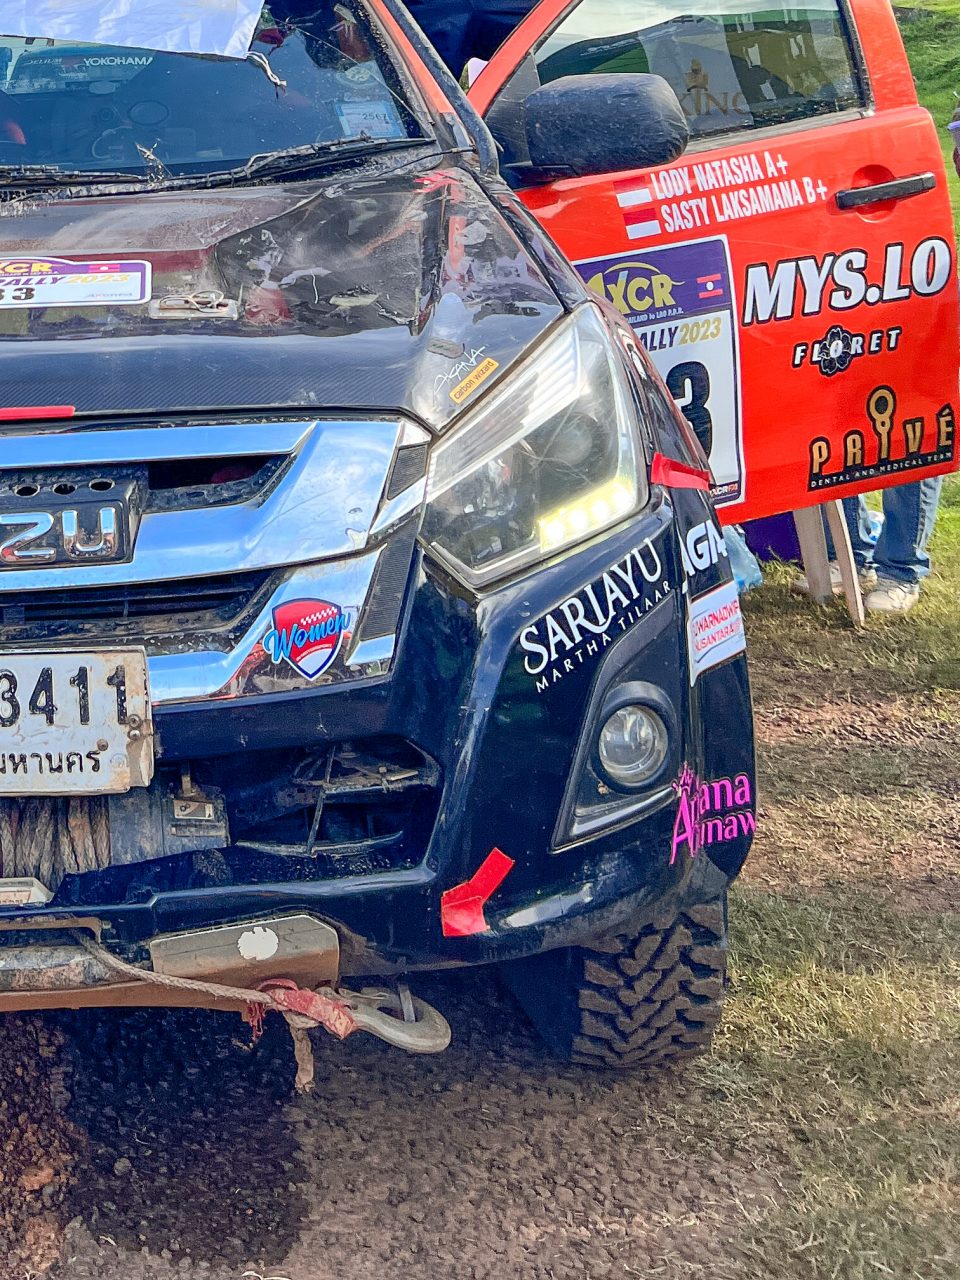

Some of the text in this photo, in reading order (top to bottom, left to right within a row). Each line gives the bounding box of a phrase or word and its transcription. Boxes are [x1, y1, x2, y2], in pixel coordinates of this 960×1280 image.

[650, 150, 788, 201] LODY NATASHA A+
[660, 176, 828, 234] SASTY LAKSAMANA B+
[66, 274, 130, 285] 2023
[742, 236, 952, 326] MYS.LO
[639, 317, 722, 352] ALLY 2023
[792, 327, 902, 368] FLORET
[474, 360, 495, 381] wizard
[810, 451, 952, 488] DENTAL AND MEDICAL TEAM
[520, 537, 662, 675] SARIAYU
[263, 611, 351, 662] Women
[536, 580, 670, 693] MARTHA TILAAR
